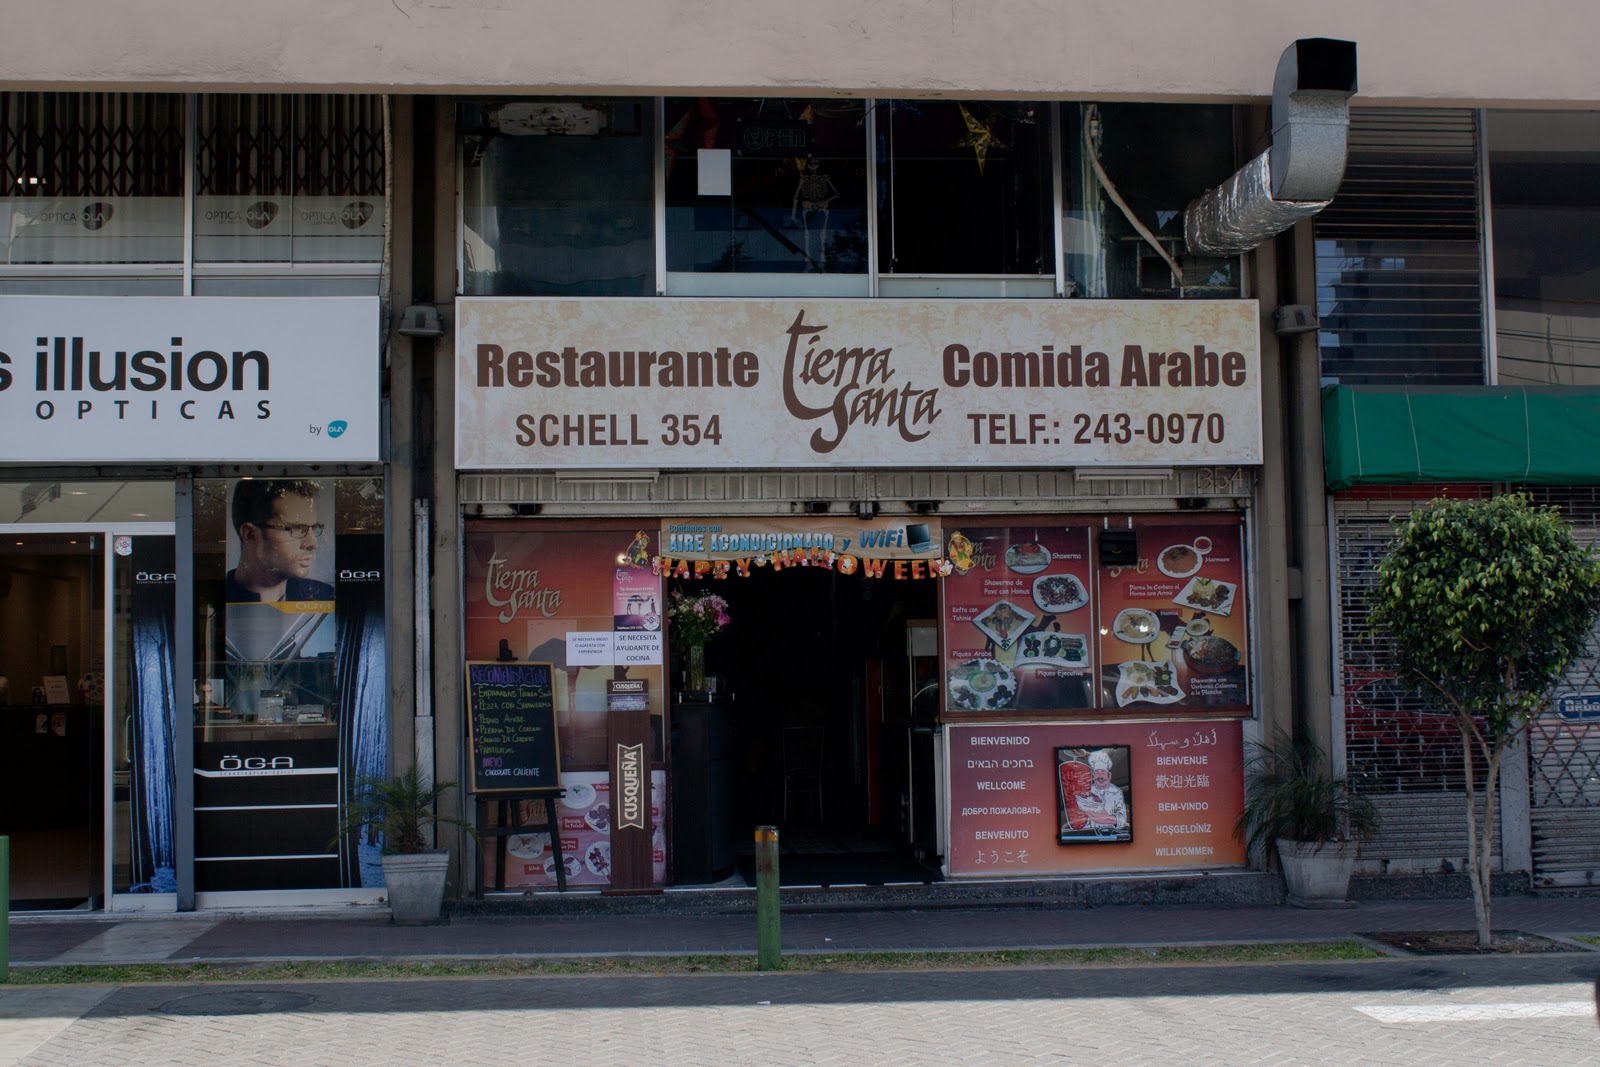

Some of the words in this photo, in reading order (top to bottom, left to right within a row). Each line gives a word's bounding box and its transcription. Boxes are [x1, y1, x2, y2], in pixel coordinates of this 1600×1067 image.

[41, 212, 77, 222] OPTICA
[205, 211, 242, 220] OPTICA
[301, 211, 337, 221] OPTICA
[36, 336, 270, 392] illusion
[476, 343, 760, 388] Restaurante
[942, 343, 1110, 388] Comida
[1120, 344, 1247, 388] Arabe
[36, 400, 271, 420] OPTICAS
[810, 381, 942, 454] Santa
[309, 423, 322, 436] by
[515, 413, 649, 447] SCHELL
[660, 414, 723, 446] 354
[1073, 412, 1226, 445] 243-0970
[1198, 467, 1243, 489] 354
[668, 524, 706, 533] Contamos
[708, 525, 723, 533] con
[669, 533, 705, 553] AIRE
[709, 532, 835, 552] ACONDICIONADO
[842, 538, 851, 551] y
[859, 528, 904, 548] WiFi
[1052, 552, 1082, 560] Shawerma
[653, 556, 752, 580] HAPPY
[772, 547, 950, 580] HALLOWEEN
[498, 588, 563, 624] Santa
[952, 650, 973, 658] Piqueo
[970, 736, 1031, 746] BIENVENIDO
[220, 754, 294, 770] ÖGA
[967, 759, 999, 769] הבאים
[1156, 755, 1209, 766] BIENVENUE
[622, 751, 640, 821] CUSQUEÑA
[976, 781, 1026, 791] WELLCOME
[1155, 774, 1210, 789] 歡迎光臨
[962, 807, 989, 817] ДОБРО
[989, 806, 1042, 815] ПОЖАЛОВАТЬ
[1158, 801, 1209, 812] BEM-VINDO
[975, 830, 1029, 840] BENVENUTO
[975, 850, 1030, 864] ようこそ
[1154, 846, 1214, 857] WILLKOMMEN
